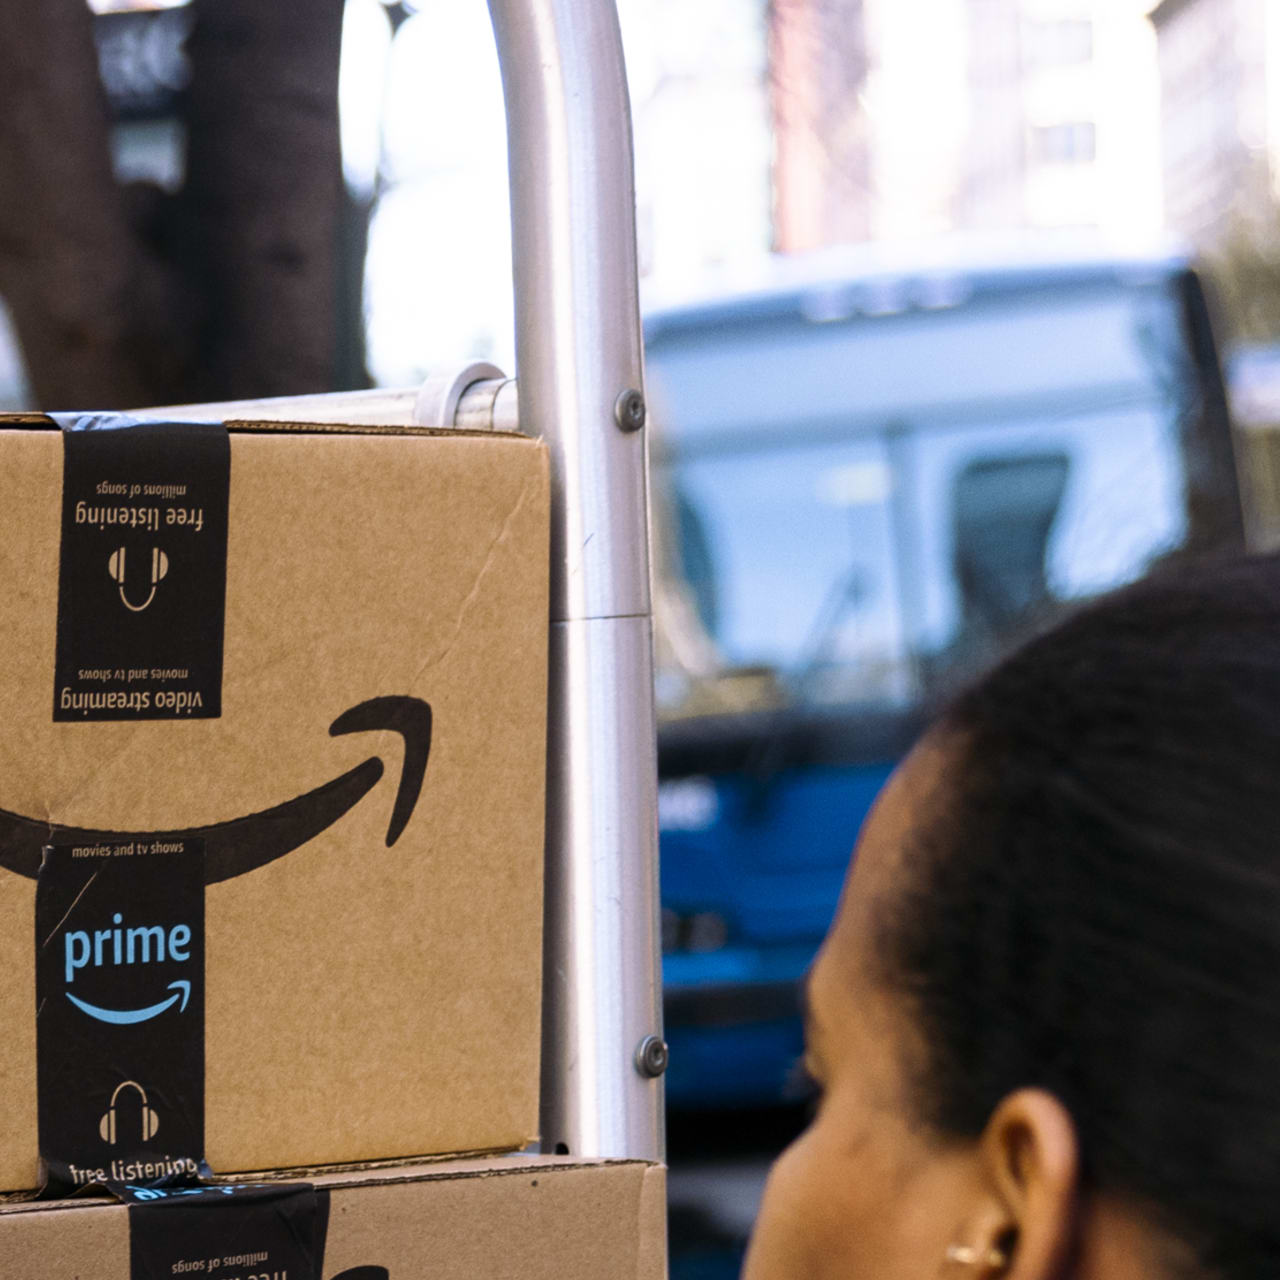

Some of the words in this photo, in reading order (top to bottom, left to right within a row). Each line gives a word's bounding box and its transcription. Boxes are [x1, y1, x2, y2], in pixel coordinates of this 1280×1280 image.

[96, 480, 127, 496] songs
[126, 483, 142, 499] of
[144, 484, 187, 500] millions
[75, 500, 159, 531] listening
[165, 506, 204, 532] free
[78, 667, 113, 681] shows
[114, 668, 127, 681] tv
[127, 668, 149, 681] and
[150, 668, 189, 683] movies
[60, 686, 151, 716] streaming
[154, 690, 203, 715] video
[71, 843, 112, 859] movies
[113, 842, 134, 857] and
[136, 842, 149, 856] tv
[150, 840, 185, 856] shows
[64, 912, 192, 984] prime
[69, 1163, 109, 1186] free
[111, 1154, 198, 1183] listening
[171, 1258, 206, 1275] songs
[206, 1256, 222, 1273] of
[223, 1250, 269, 1268] millions
